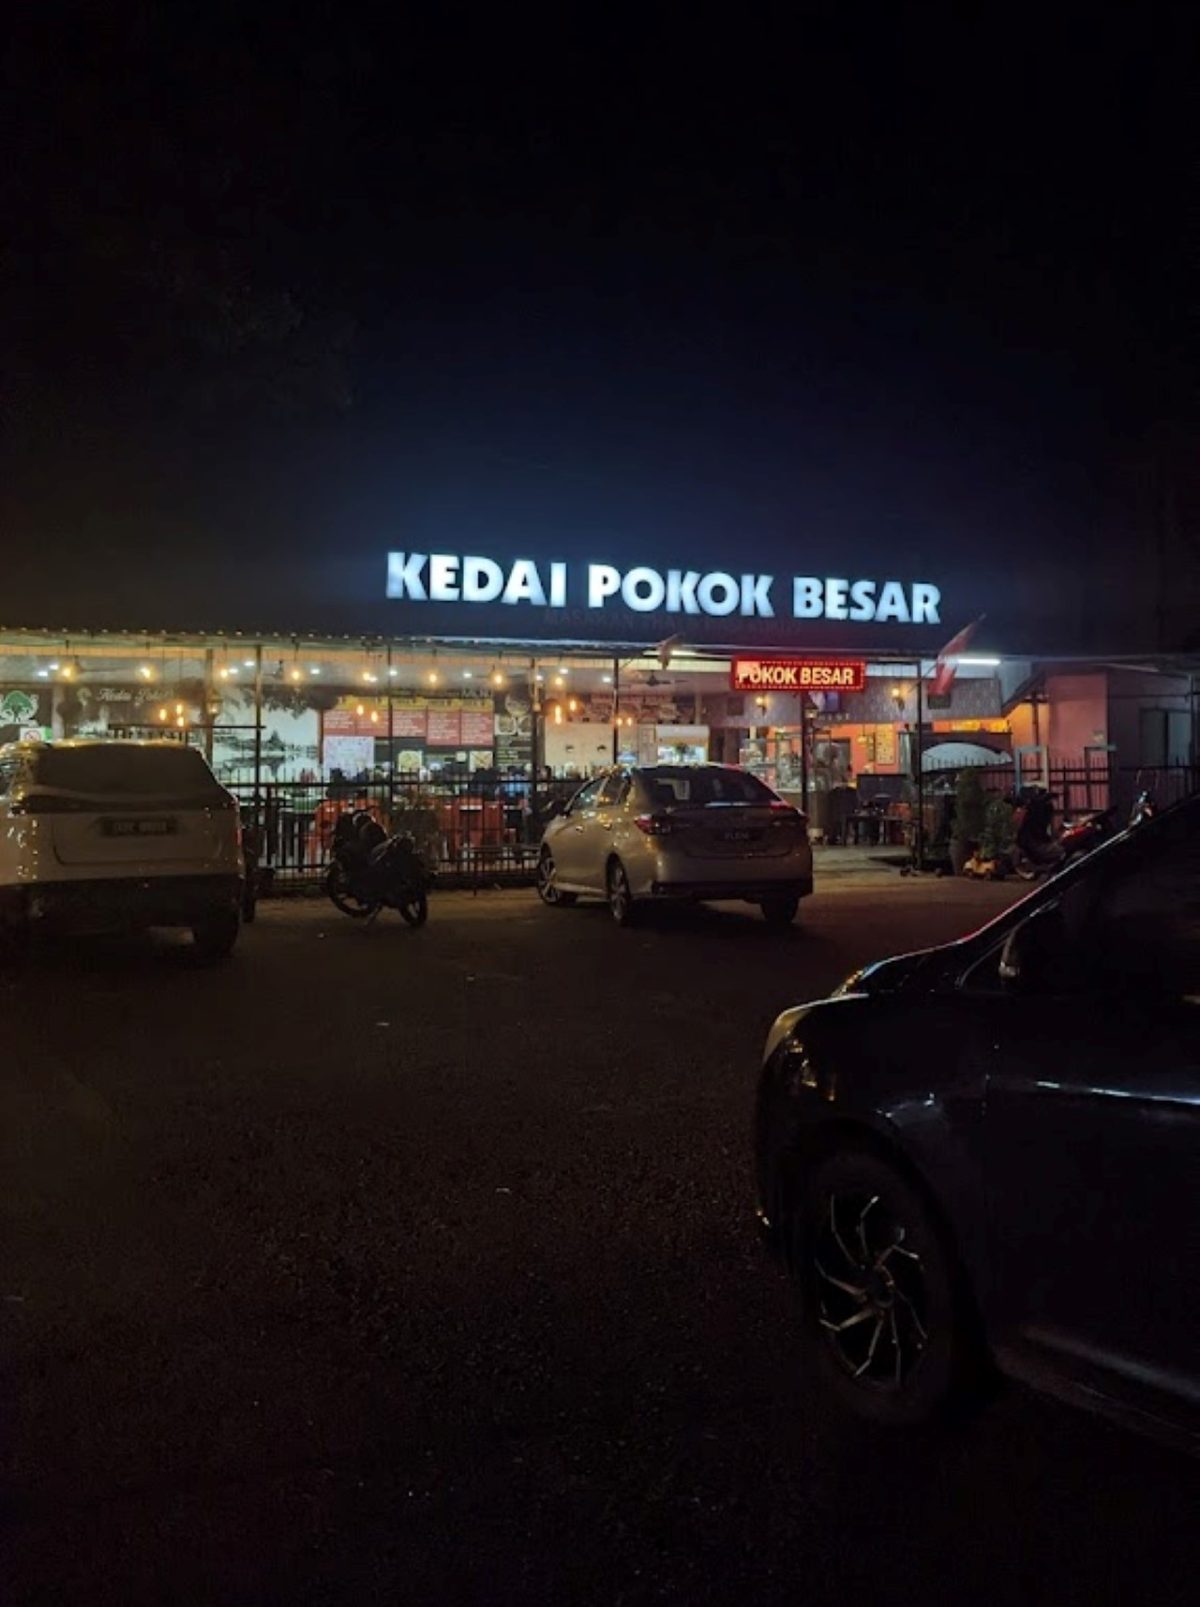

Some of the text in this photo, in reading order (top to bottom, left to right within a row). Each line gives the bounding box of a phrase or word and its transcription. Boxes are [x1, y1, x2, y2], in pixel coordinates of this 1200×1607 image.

[386, 551, 942, 625] KEDAI POKOK BESAR
[800, 667, 854, 685] BESAR
